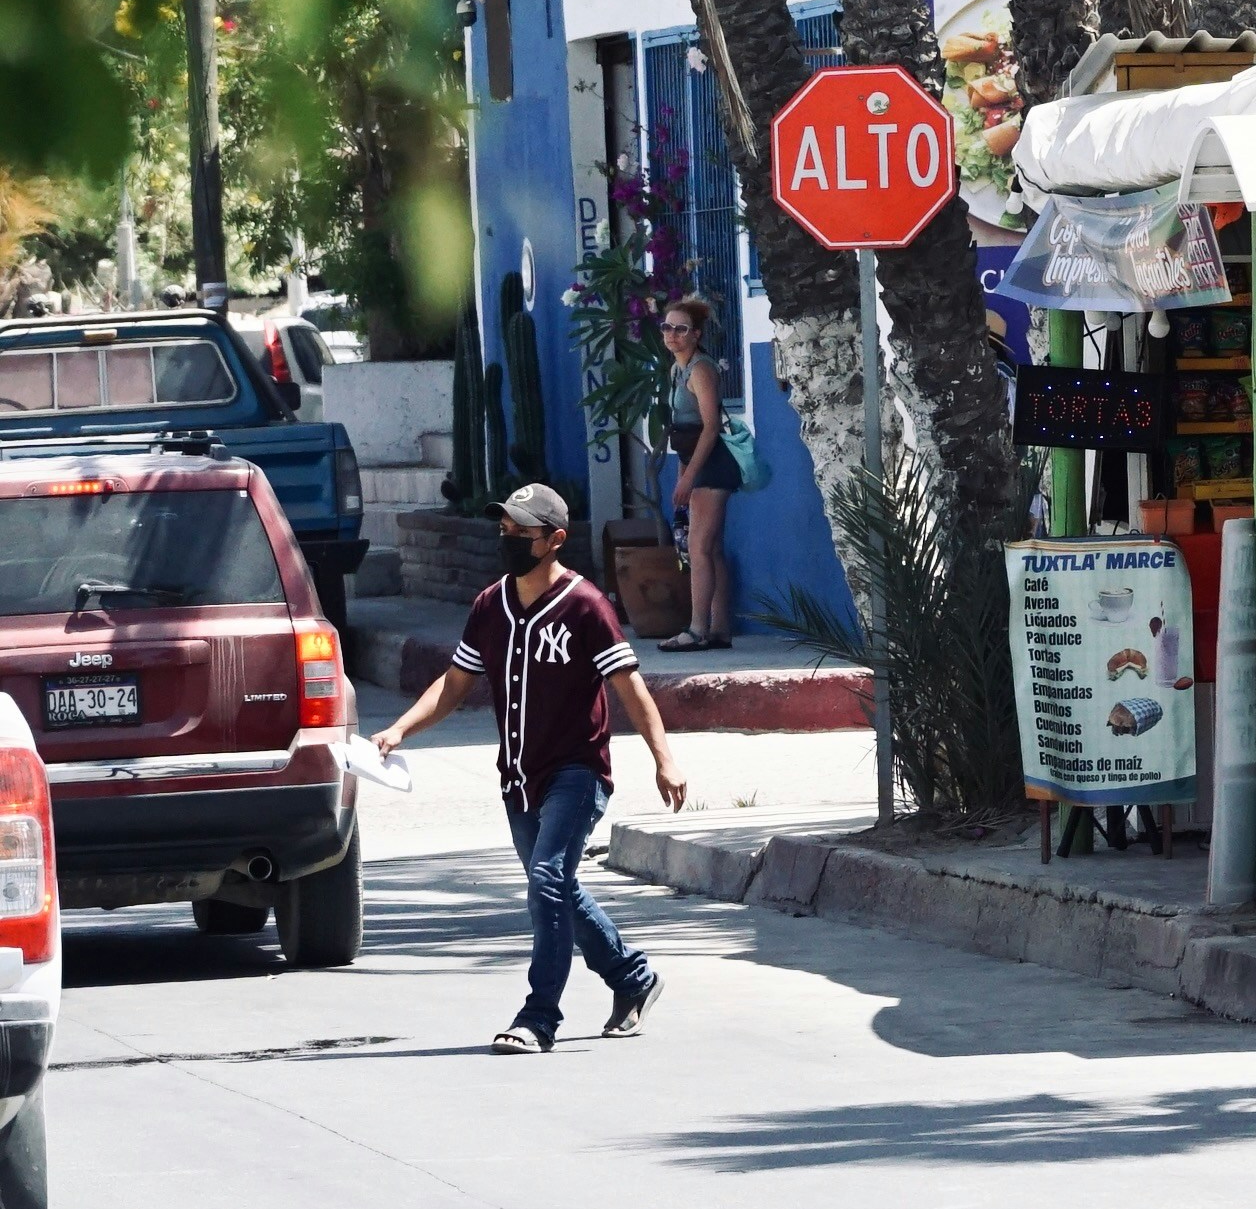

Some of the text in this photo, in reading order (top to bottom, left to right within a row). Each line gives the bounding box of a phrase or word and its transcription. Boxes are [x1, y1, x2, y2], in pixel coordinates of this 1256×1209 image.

[790, 123, 940, 191] ALTO
[1028, 393, 1151, 428] TORTAS
[1106, 551, 1176, 570] MARCE
[1024, 577, 1049, 592] Café
[1024, 596, 1059, 610] Avena
[1025, 612, 1077, 628] Licuados
[535, 622, 572, 664] NY
[1026, 631, 1082, 646] Pan dulce
[69, 652, 113, 668] Jeep
[1028, 649, 1061, 664] Tortas
[1030, 666, 1074, 682] Tamales
[244, 693, 288, 702] LIMITED
[1033, 683, 1093, 700] Empanadas
[48, 710, 87, 722] ROCA
[1034, 700, 1072, 717] Burritos
[1036, 717, 1082, 735] Cuernitos
[1038, 735, 1083, 753] Sandwich
[1039, 752, 1143, 772] Empanadas de maíz
[1076, 772, 1100, 783] queso
[1108, 771, 1127, 783] tinga
[1129, 771, 1138, 781] de
[1140, 771, 1161, 782] pollo)
